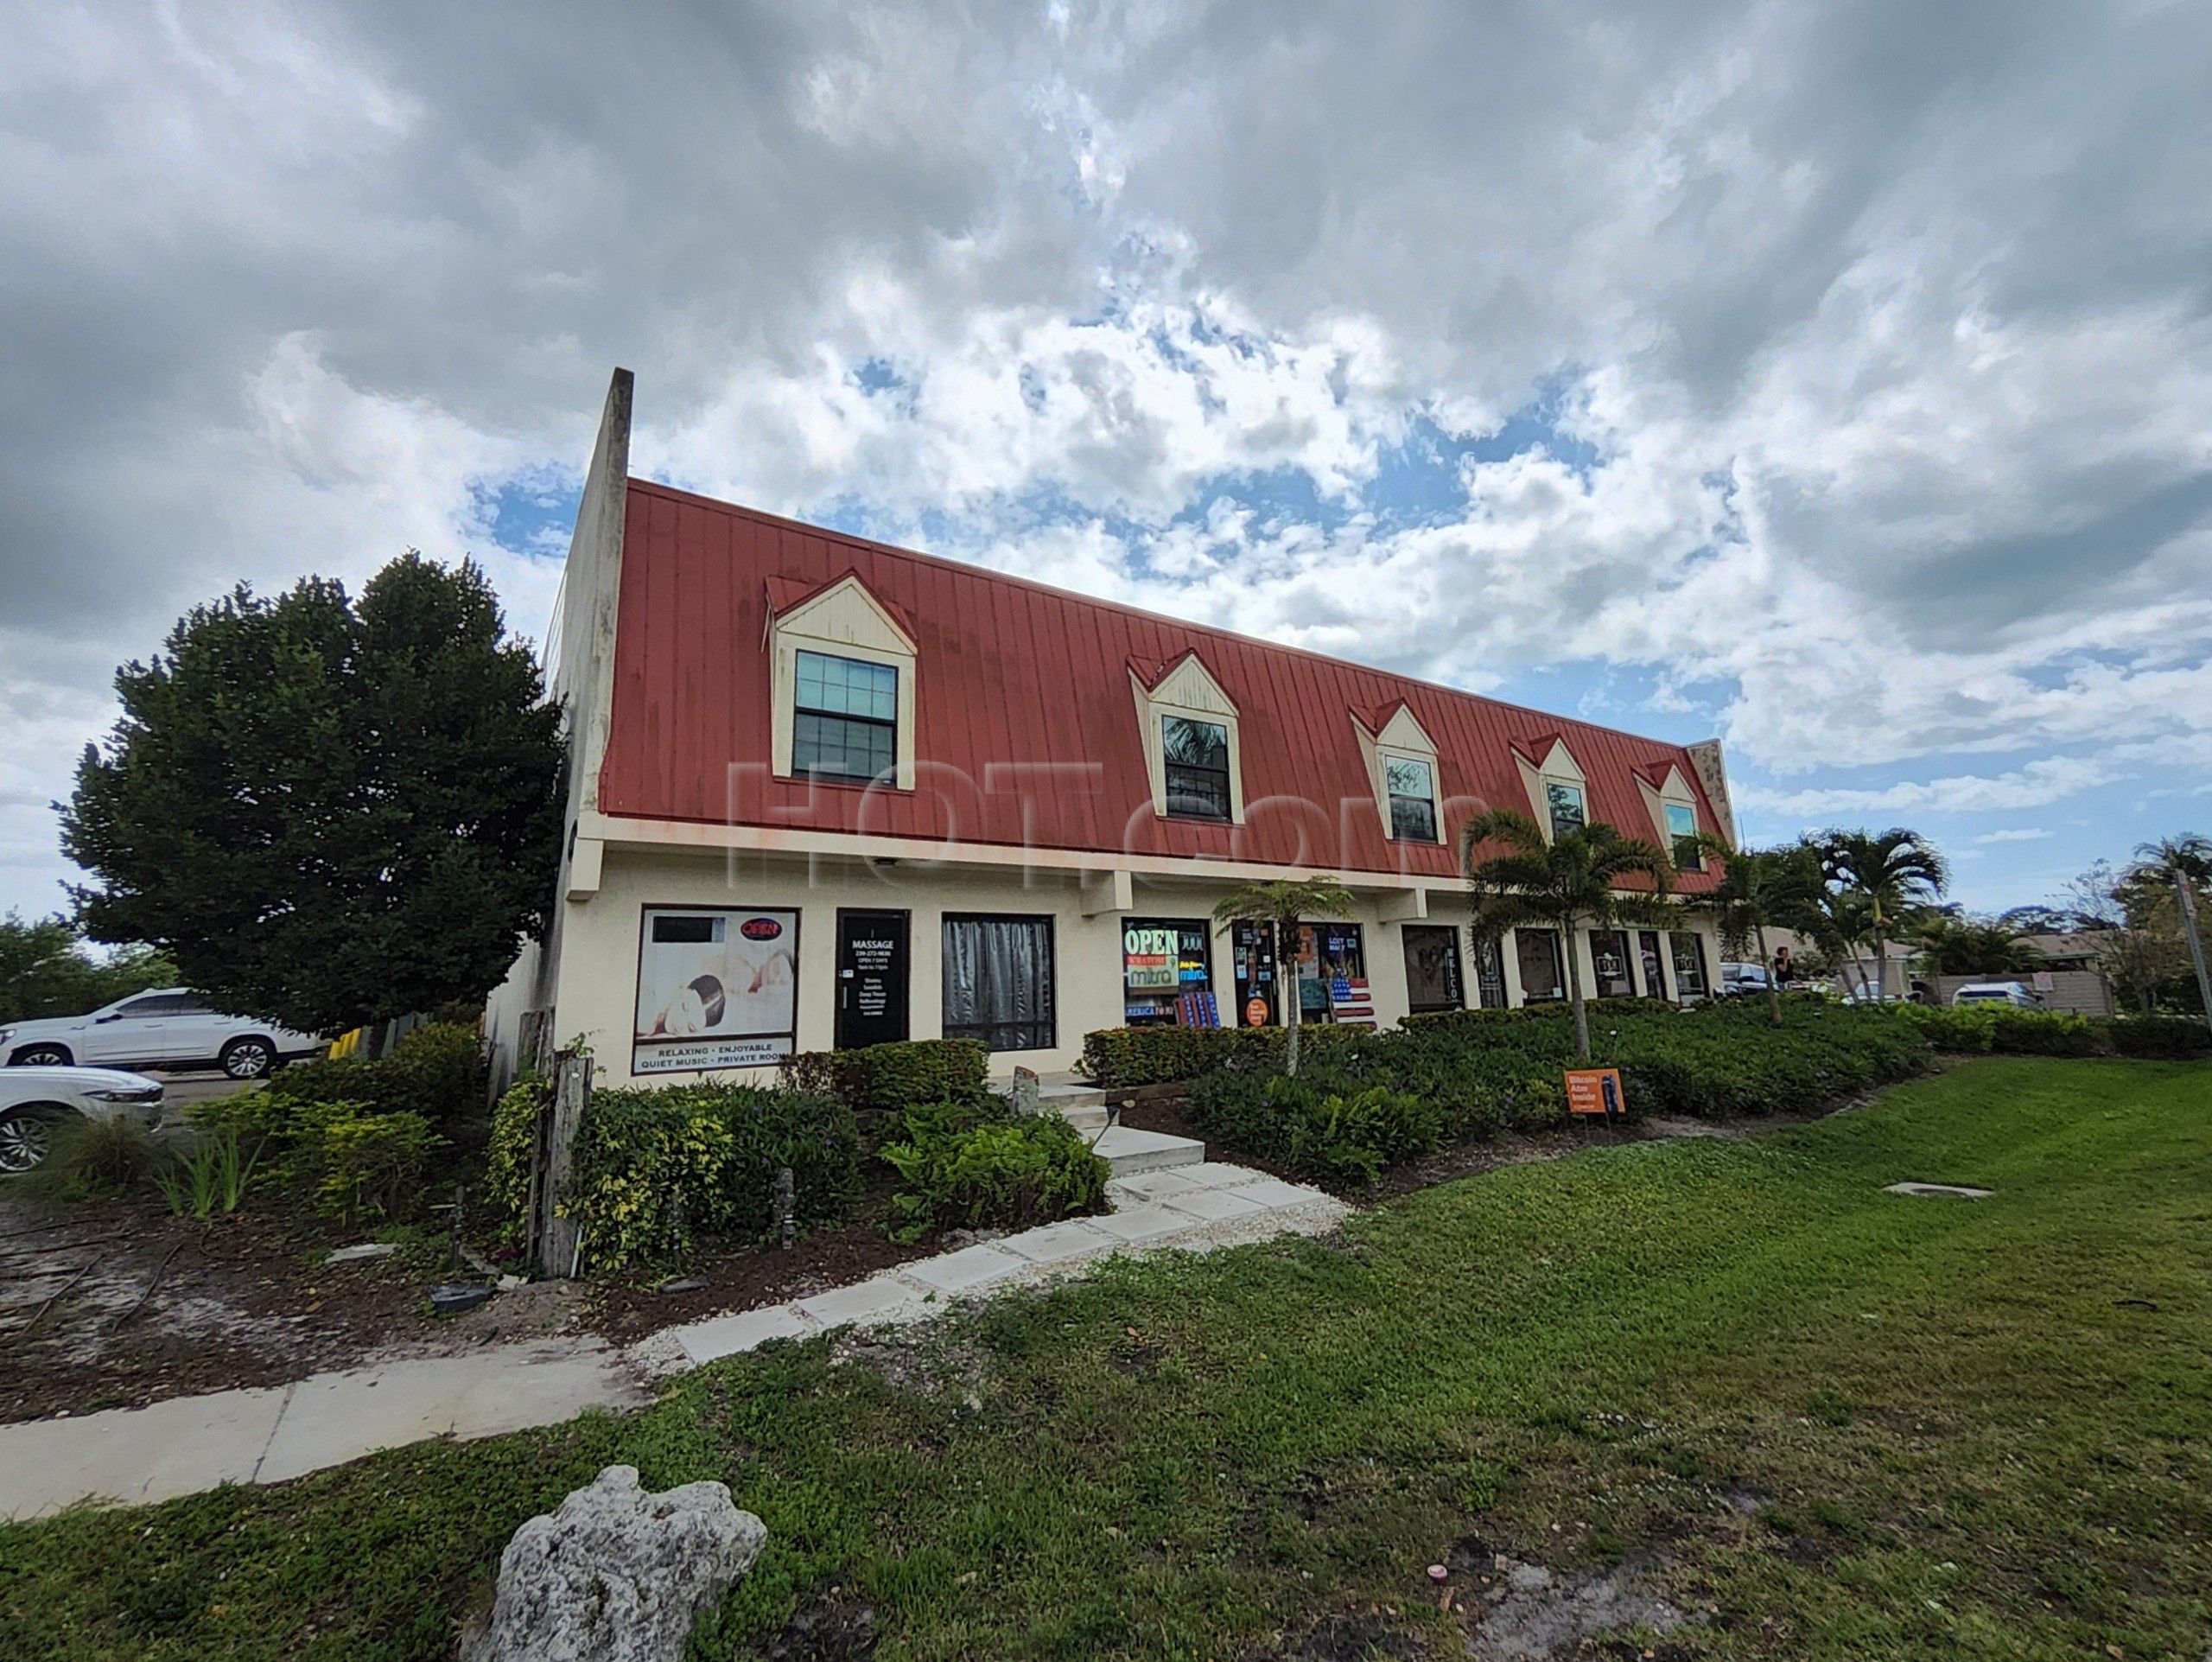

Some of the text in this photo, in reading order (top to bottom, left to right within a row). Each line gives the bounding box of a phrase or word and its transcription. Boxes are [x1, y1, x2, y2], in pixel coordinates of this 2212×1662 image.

[742, 922, 778, 935] OPEN
[852, 939, 893, 949] MASSAGE
[1125, 929, 1179, 955] OPEN
[1131, 967, 1172, 984] mitra
[658, 1044, 772, 1057] RELAXING ENJOYABLE
[641, 1060, 673, 1068] QUIET
[676, 1057, 708, 1066] MUSIC
[717, 1054, 756, 1063] PRIVATE
[1569, 1075, 1598, 1084] Bitcoin
